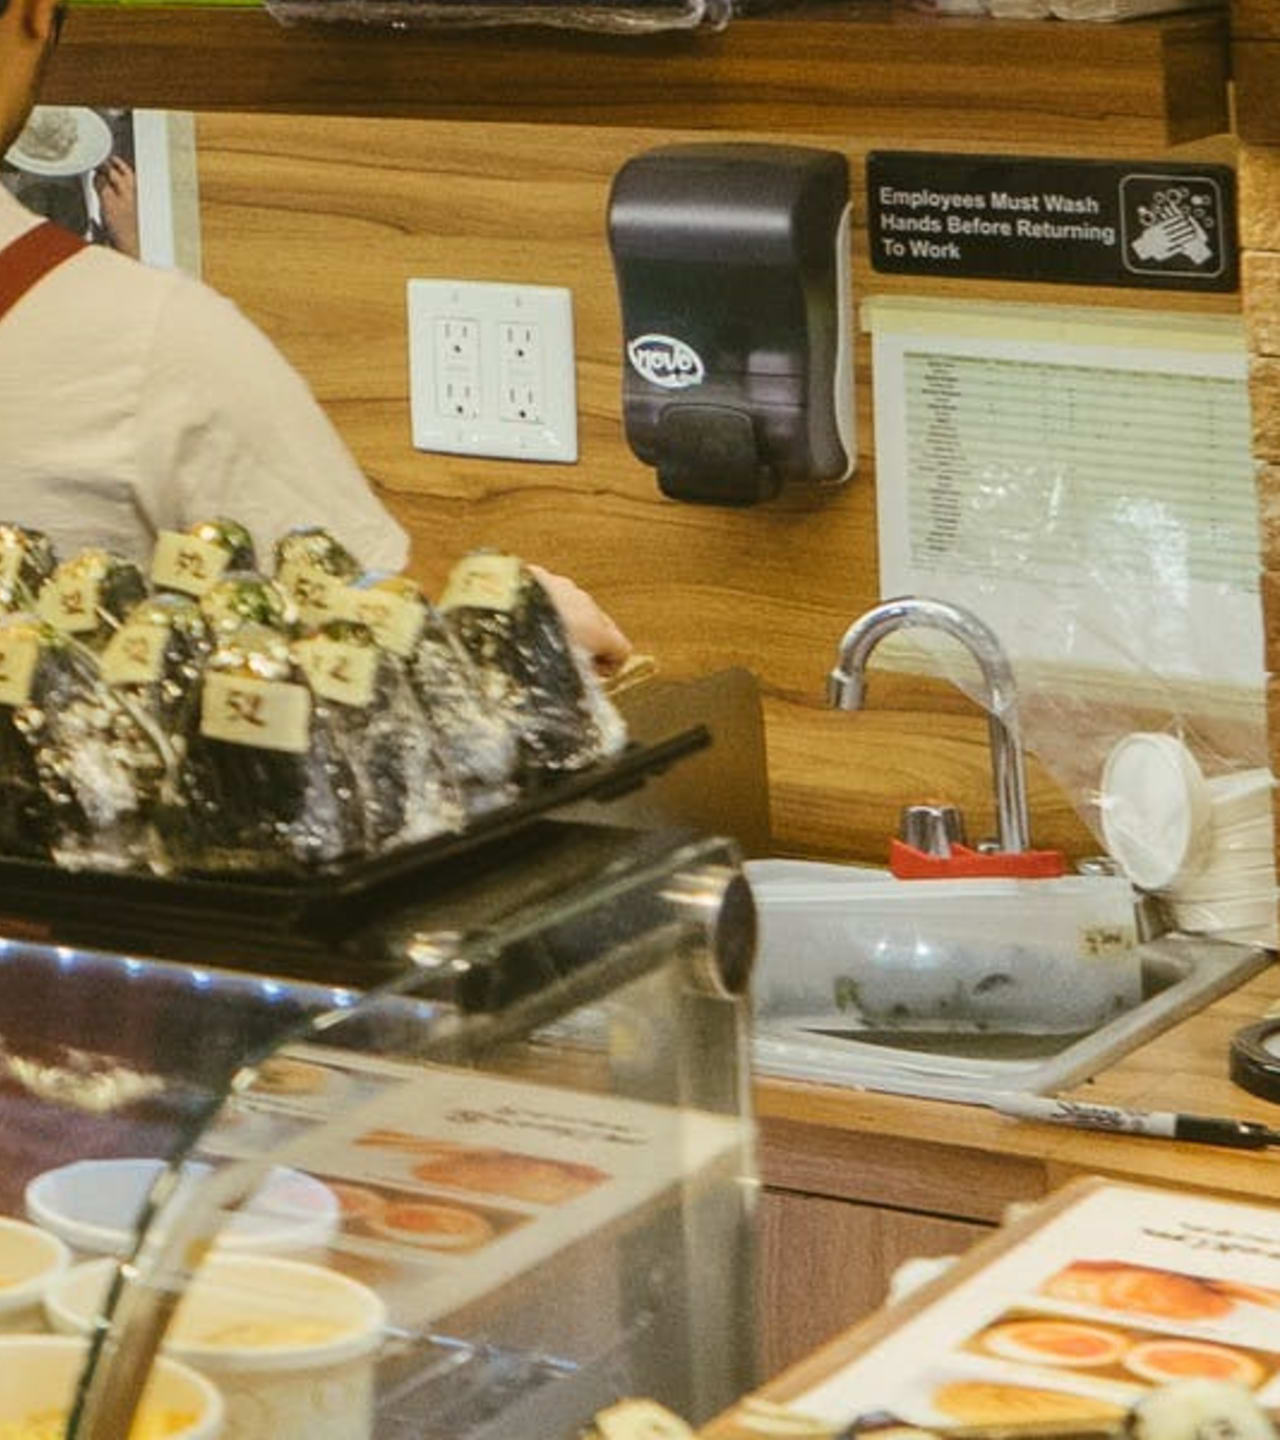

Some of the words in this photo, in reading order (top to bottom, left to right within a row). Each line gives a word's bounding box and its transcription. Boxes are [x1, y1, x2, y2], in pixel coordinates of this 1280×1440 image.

[879, 187, 986, 212] Employees
[991, 192, 1039, 211] Must
[1043, 194, 1100, 214] Wash
[880, 213, 942, 233] Hands
[947, 216, 1011, 236] Before
[1016, 219, 1115, 245] Returning
[883, 238, 905, 256] To
[909, 240, 960, 259] Work
